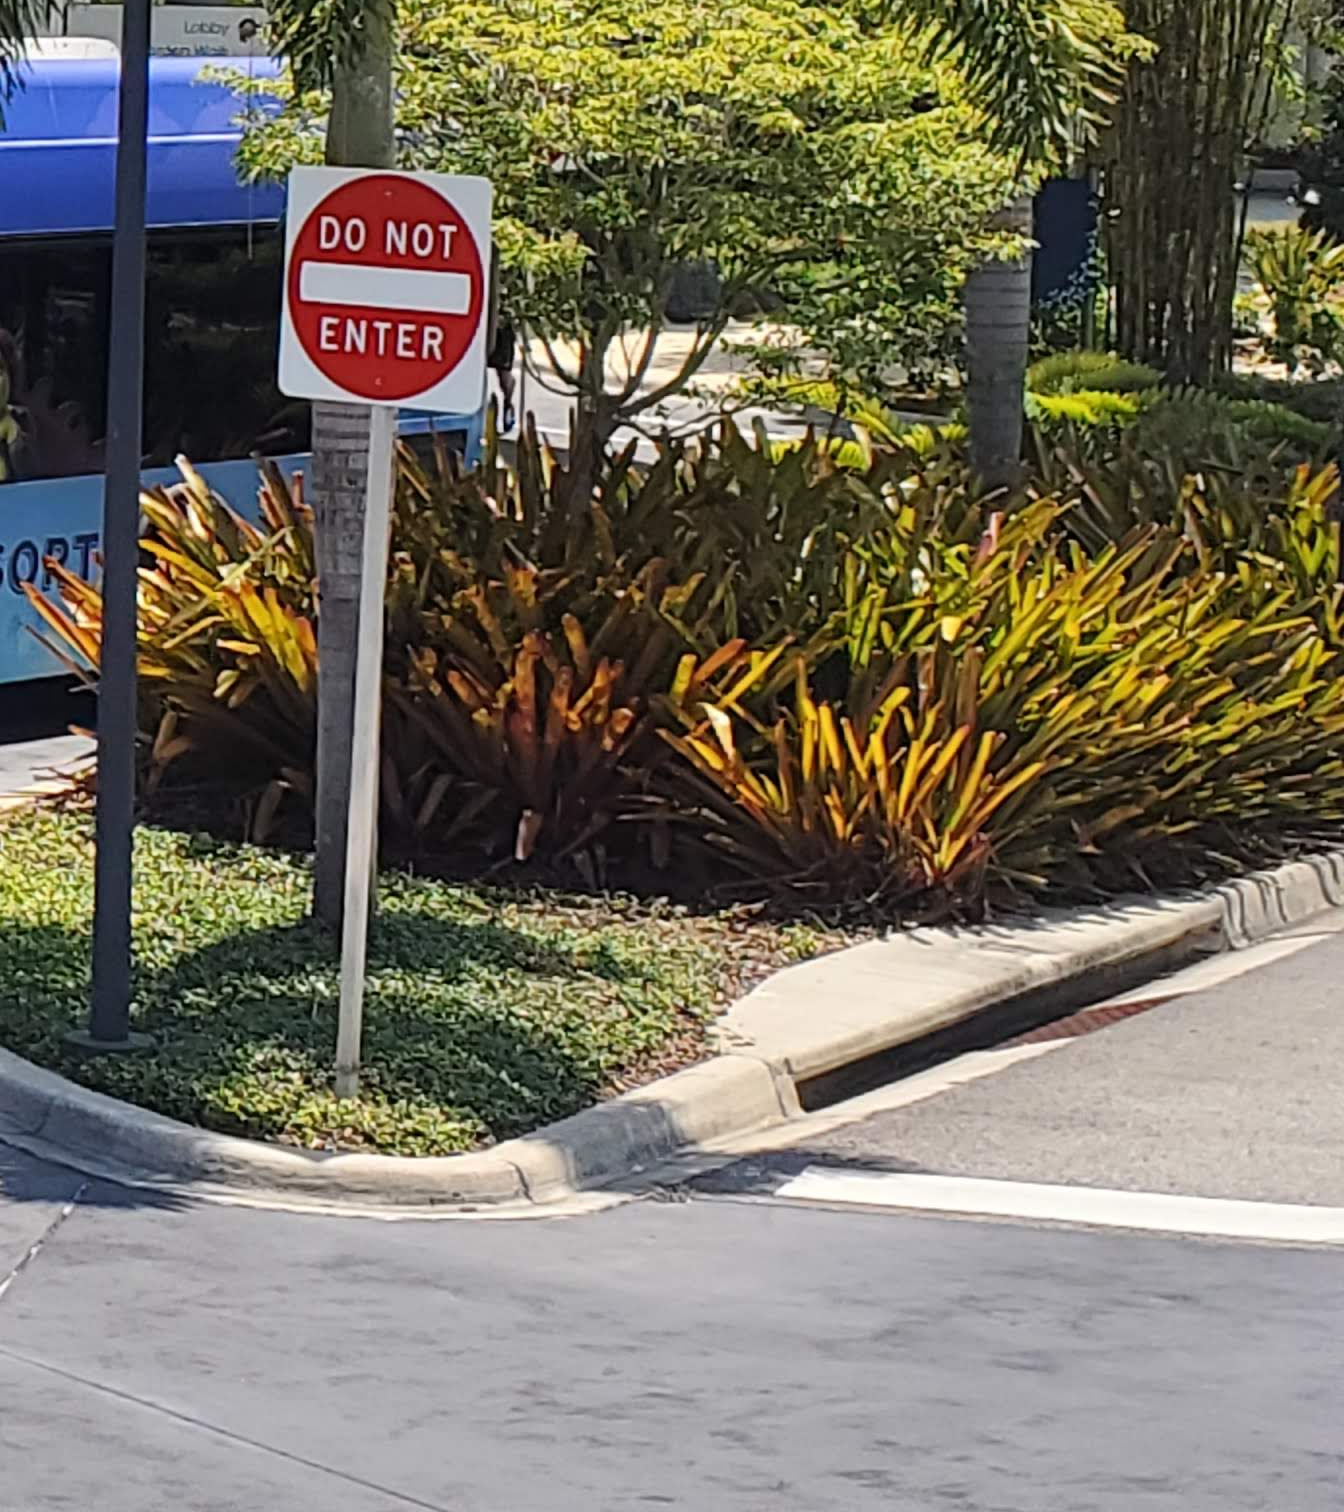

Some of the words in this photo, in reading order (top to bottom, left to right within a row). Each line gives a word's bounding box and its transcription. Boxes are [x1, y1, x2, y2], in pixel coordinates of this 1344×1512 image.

[184, 20, 230, 36] Lobby
[319, 215, 367, 252] DO
[385, 220, 458, 259] NOT
[319, 316, 444, 361] ENTER
